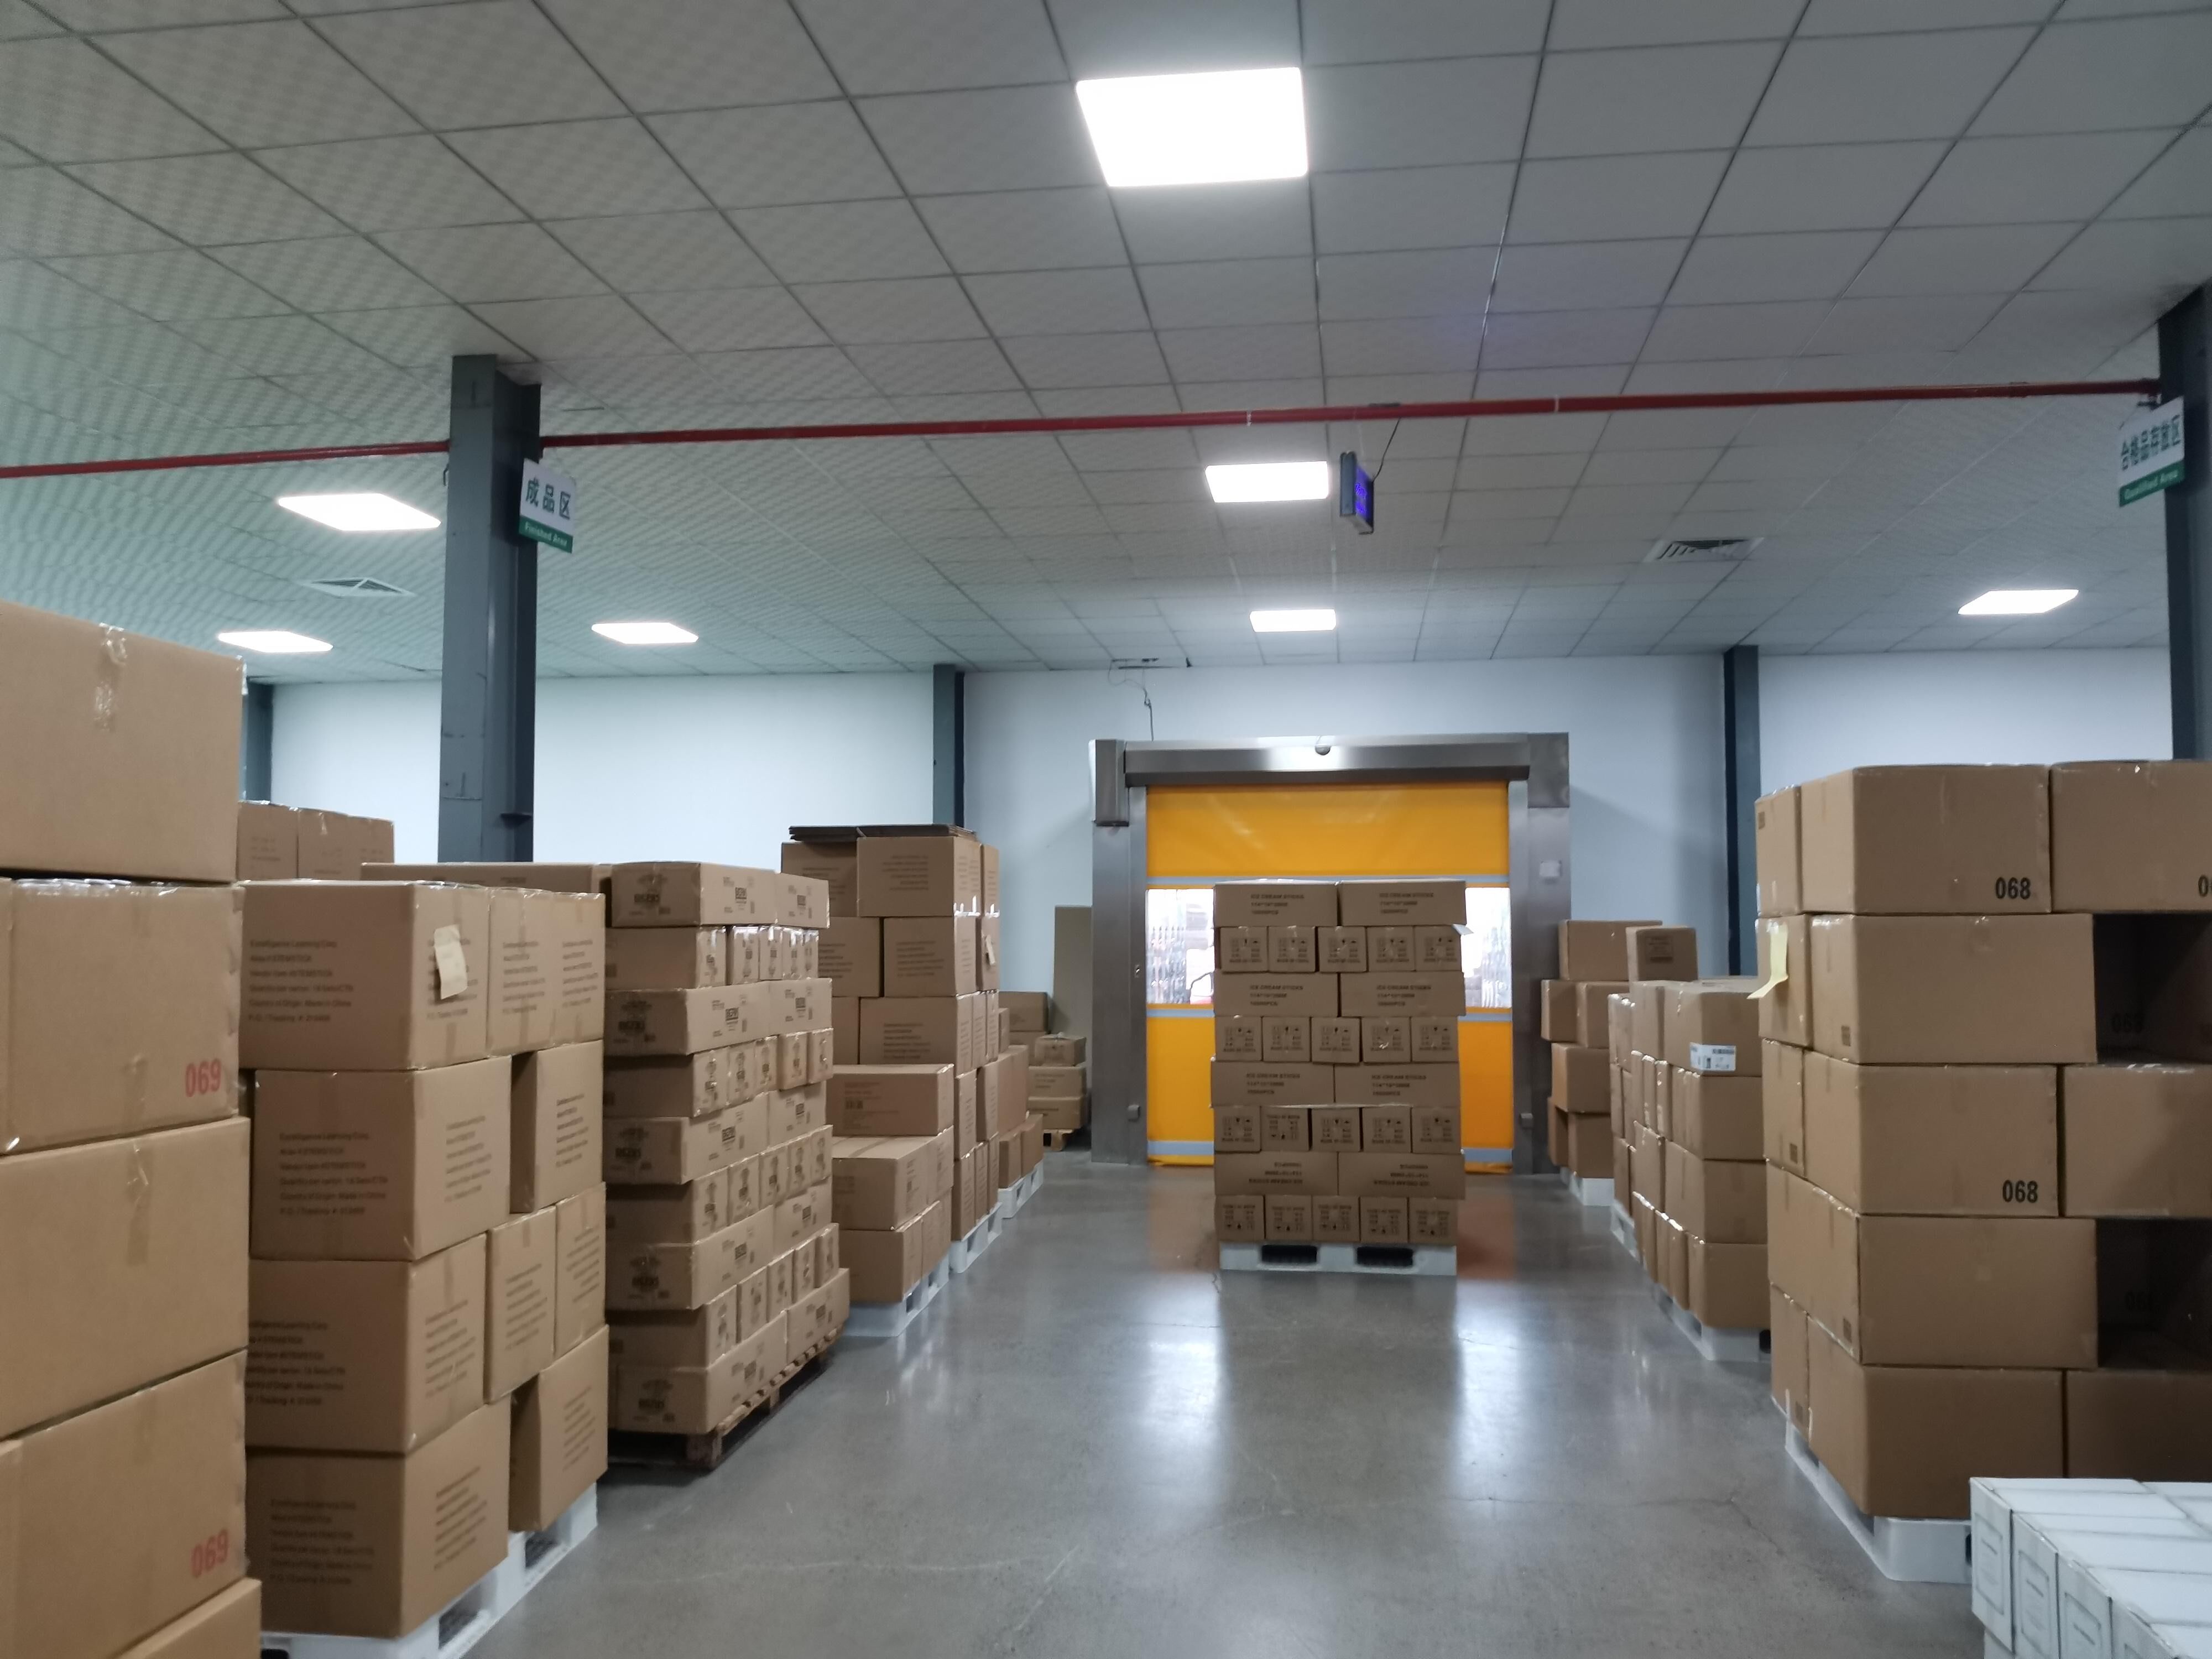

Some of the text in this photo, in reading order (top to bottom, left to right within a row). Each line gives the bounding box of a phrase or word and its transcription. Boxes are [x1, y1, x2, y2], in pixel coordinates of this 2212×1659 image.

[525, 477, 571, 520] 成品区
[1995, 877, 2031, 900] 068
[2198, 875, 2212, 897] 0
[184, 1058, 222, 1098] 069
[2002, 1180, 2038, 1204] 068
[191, 1529, 229, 1578] 069
